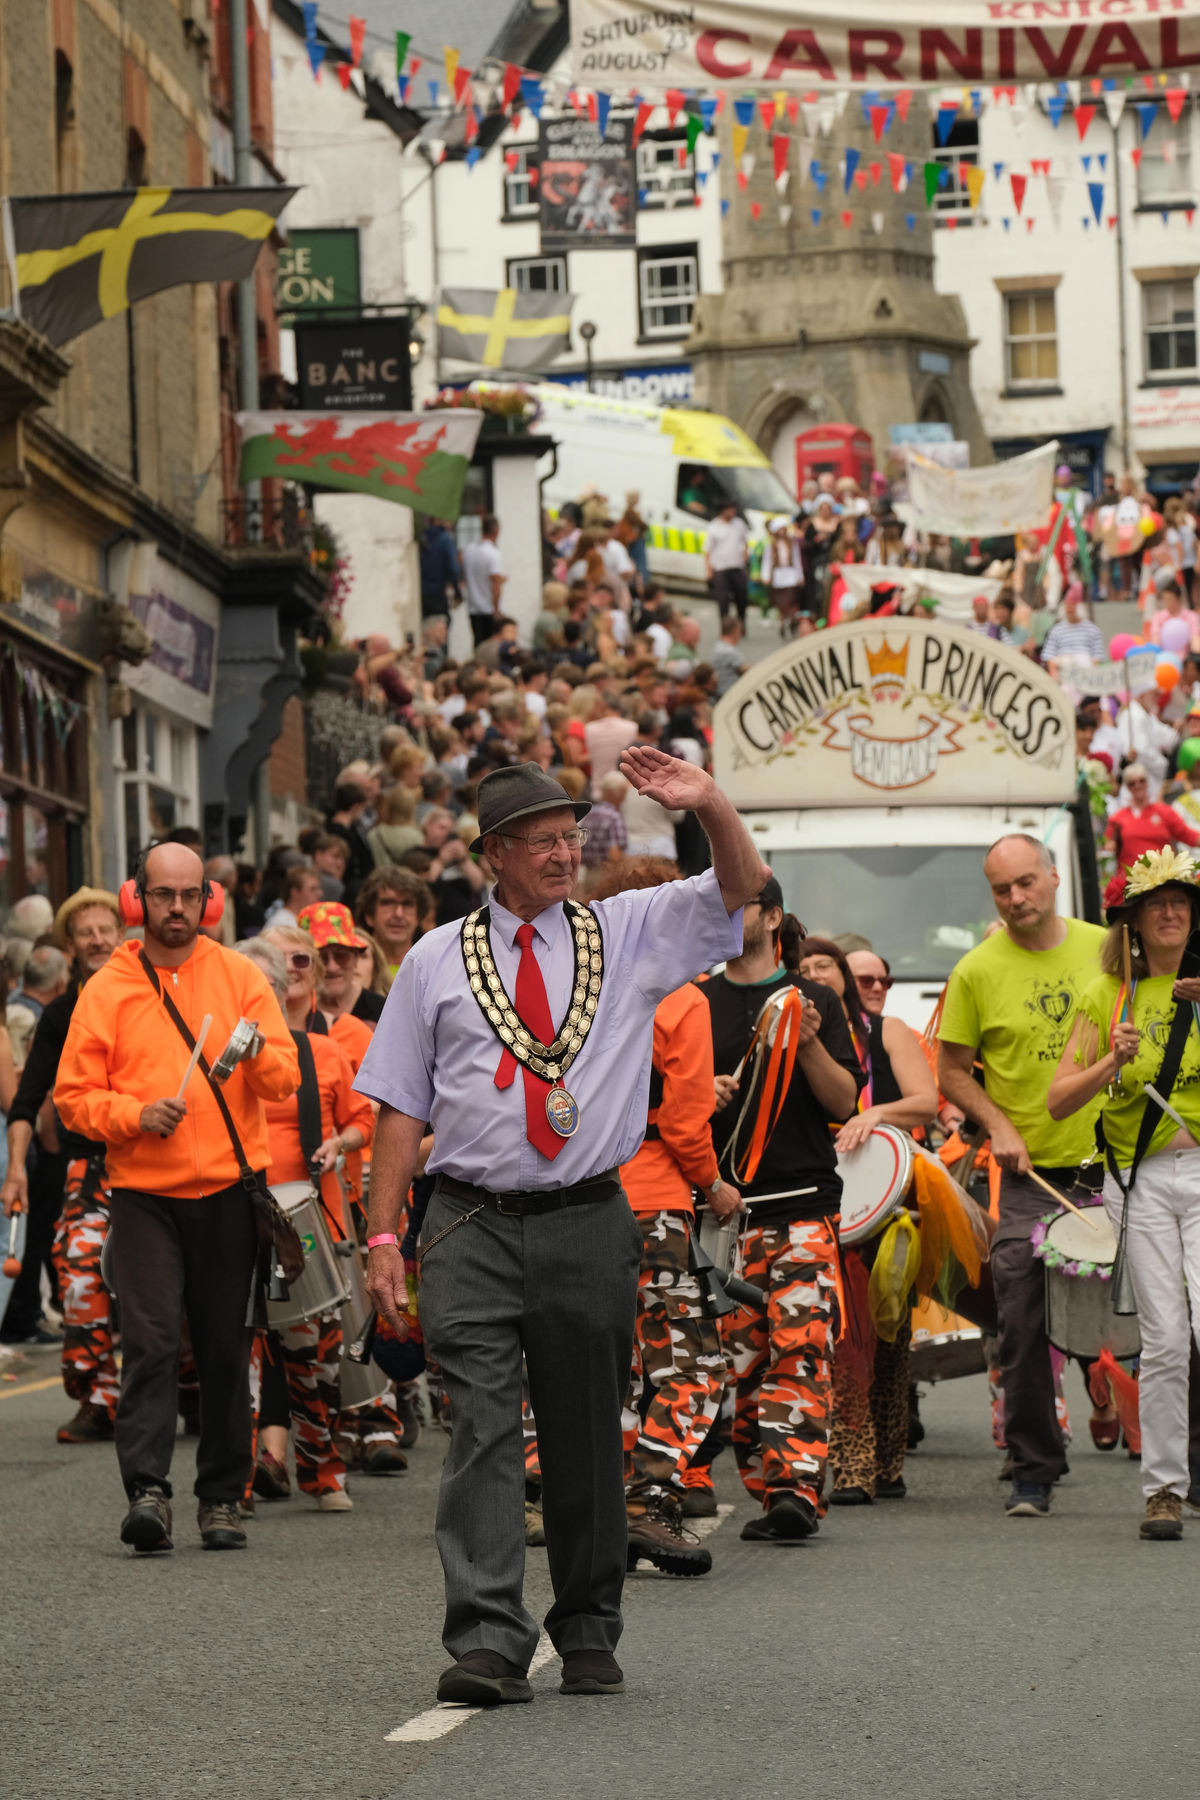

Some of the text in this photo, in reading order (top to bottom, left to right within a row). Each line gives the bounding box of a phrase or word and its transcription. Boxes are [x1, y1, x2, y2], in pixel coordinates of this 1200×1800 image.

[581, 8, 694, 48] SATURDAY
[581, 52, 670, 71] AUGUST
[695, 17, 1200, 80] CARNIVAL
[307, 358, 399, 386] BANC
[739, 635, 1061, 755] CARNIVAL PRINCESS
